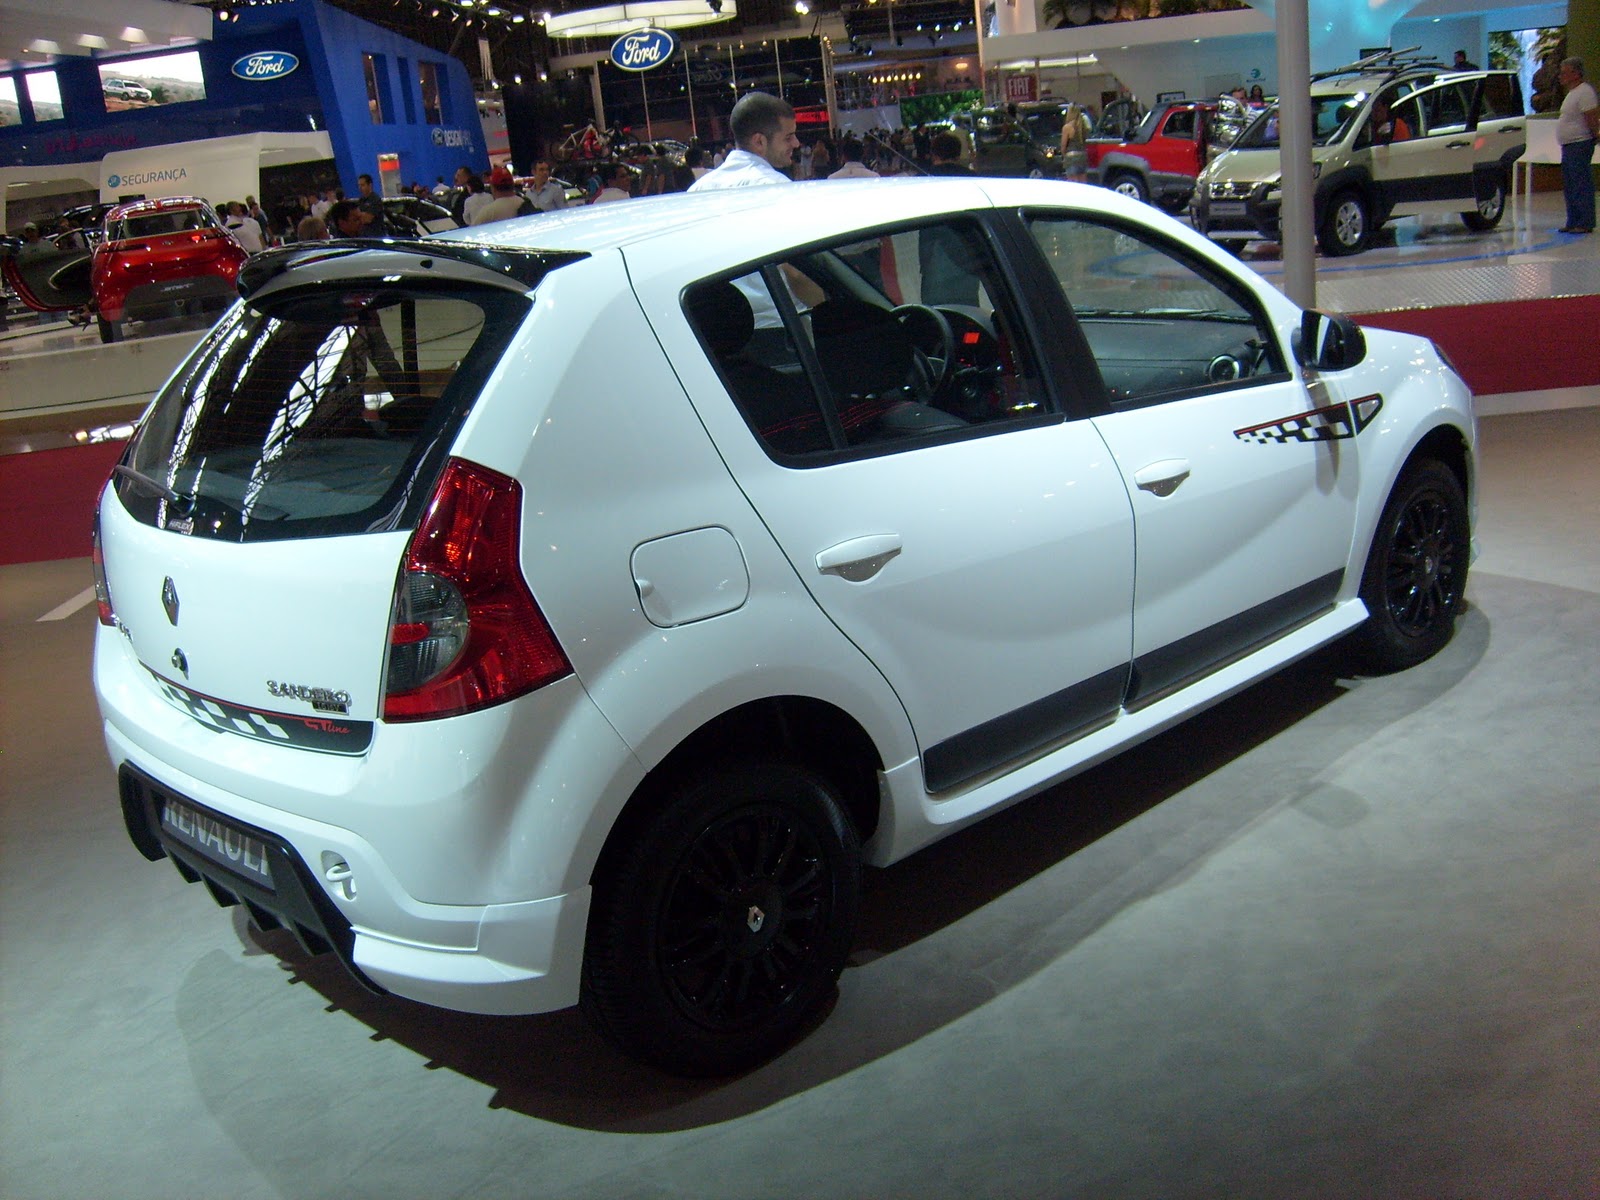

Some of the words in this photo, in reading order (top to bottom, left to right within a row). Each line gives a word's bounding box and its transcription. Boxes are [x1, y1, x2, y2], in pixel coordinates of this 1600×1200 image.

[622, 35, 660, 65] Ford
[245, 55, 284, 76] Ford
[1008, 77, 1030, 96] FIAT
[121, 168, 187, 187] SEGURANÇA
[266, 680, 352, 706] SANDERO
